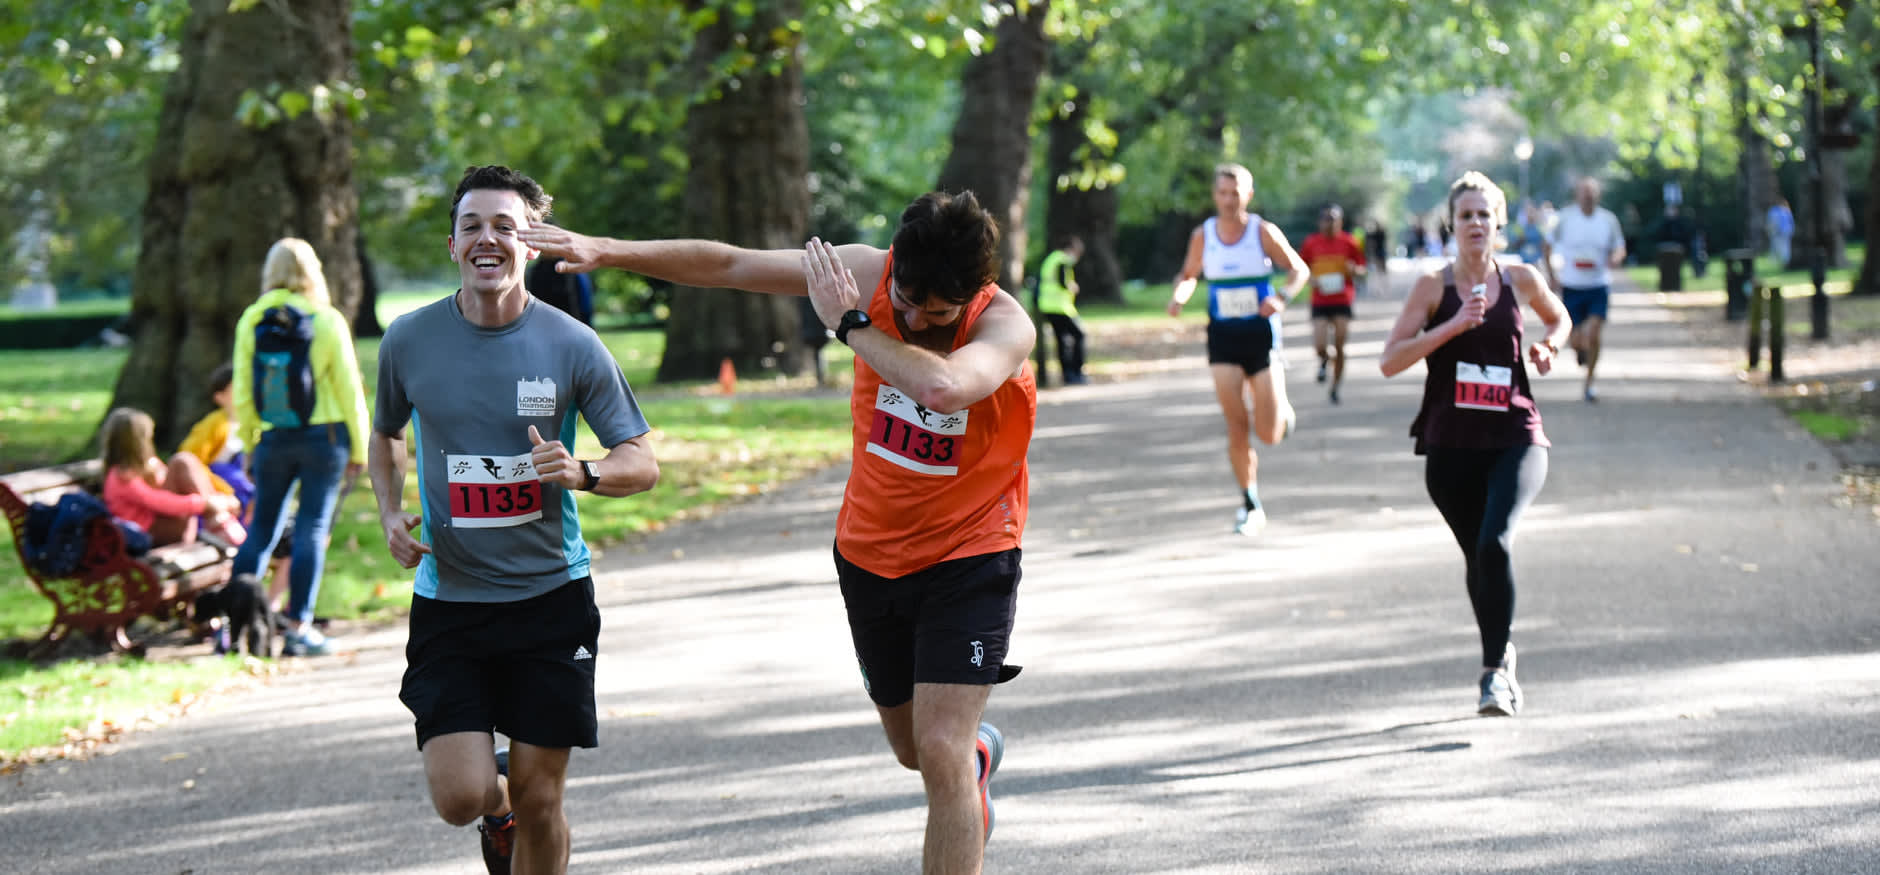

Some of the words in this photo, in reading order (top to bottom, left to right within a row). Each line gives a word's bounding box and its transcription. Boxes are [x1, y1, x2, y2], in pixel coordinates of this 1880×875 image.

[1460, 383, 1510, 404] 1140
[882, 415, 954, 462] 1133
[460, 484, 534, 513] 1135
